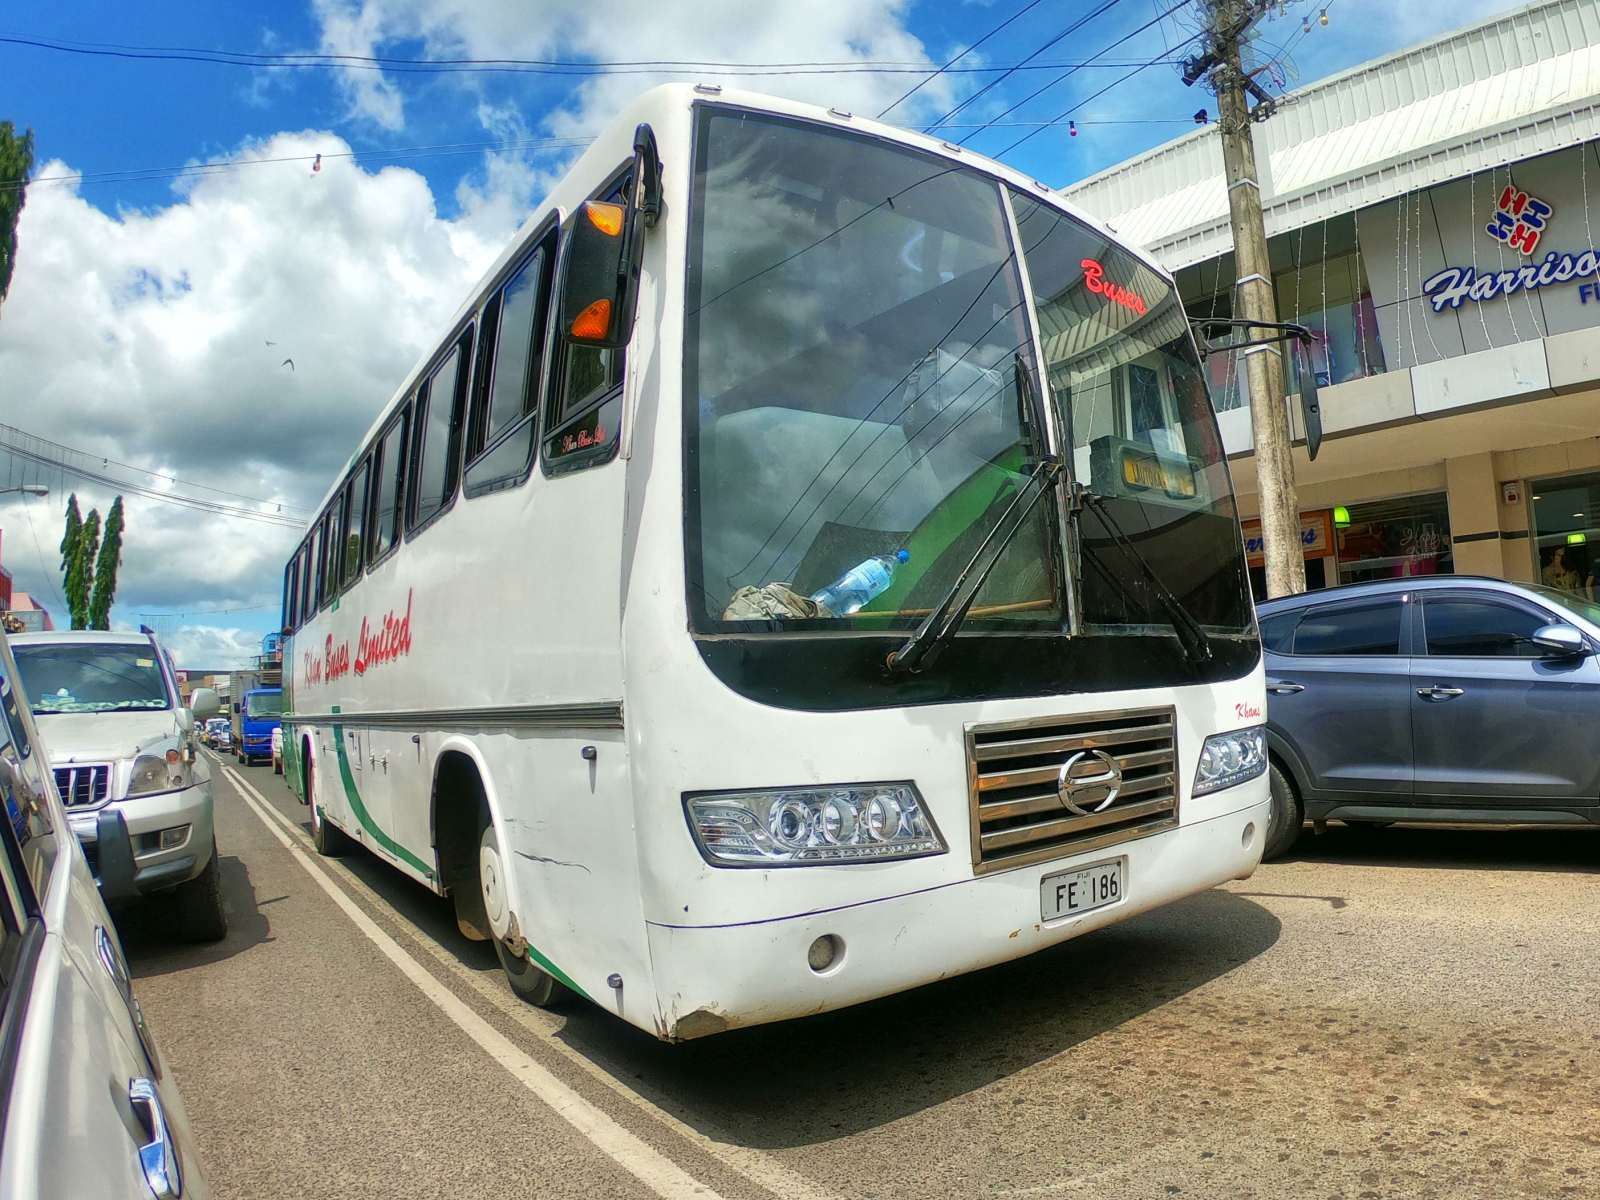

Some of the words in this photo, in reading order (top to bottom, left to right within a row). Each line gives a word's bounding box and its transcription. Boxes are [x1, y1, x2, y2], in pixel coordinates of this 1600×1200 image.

[1080, 258, 1147, 315] Buses
[325, 632, 349, 684] Buses
[354, 586, 412, 677] Limited
[1056, 882, 1079, 913] FE
[1092, 871, 1118, 903] 186
